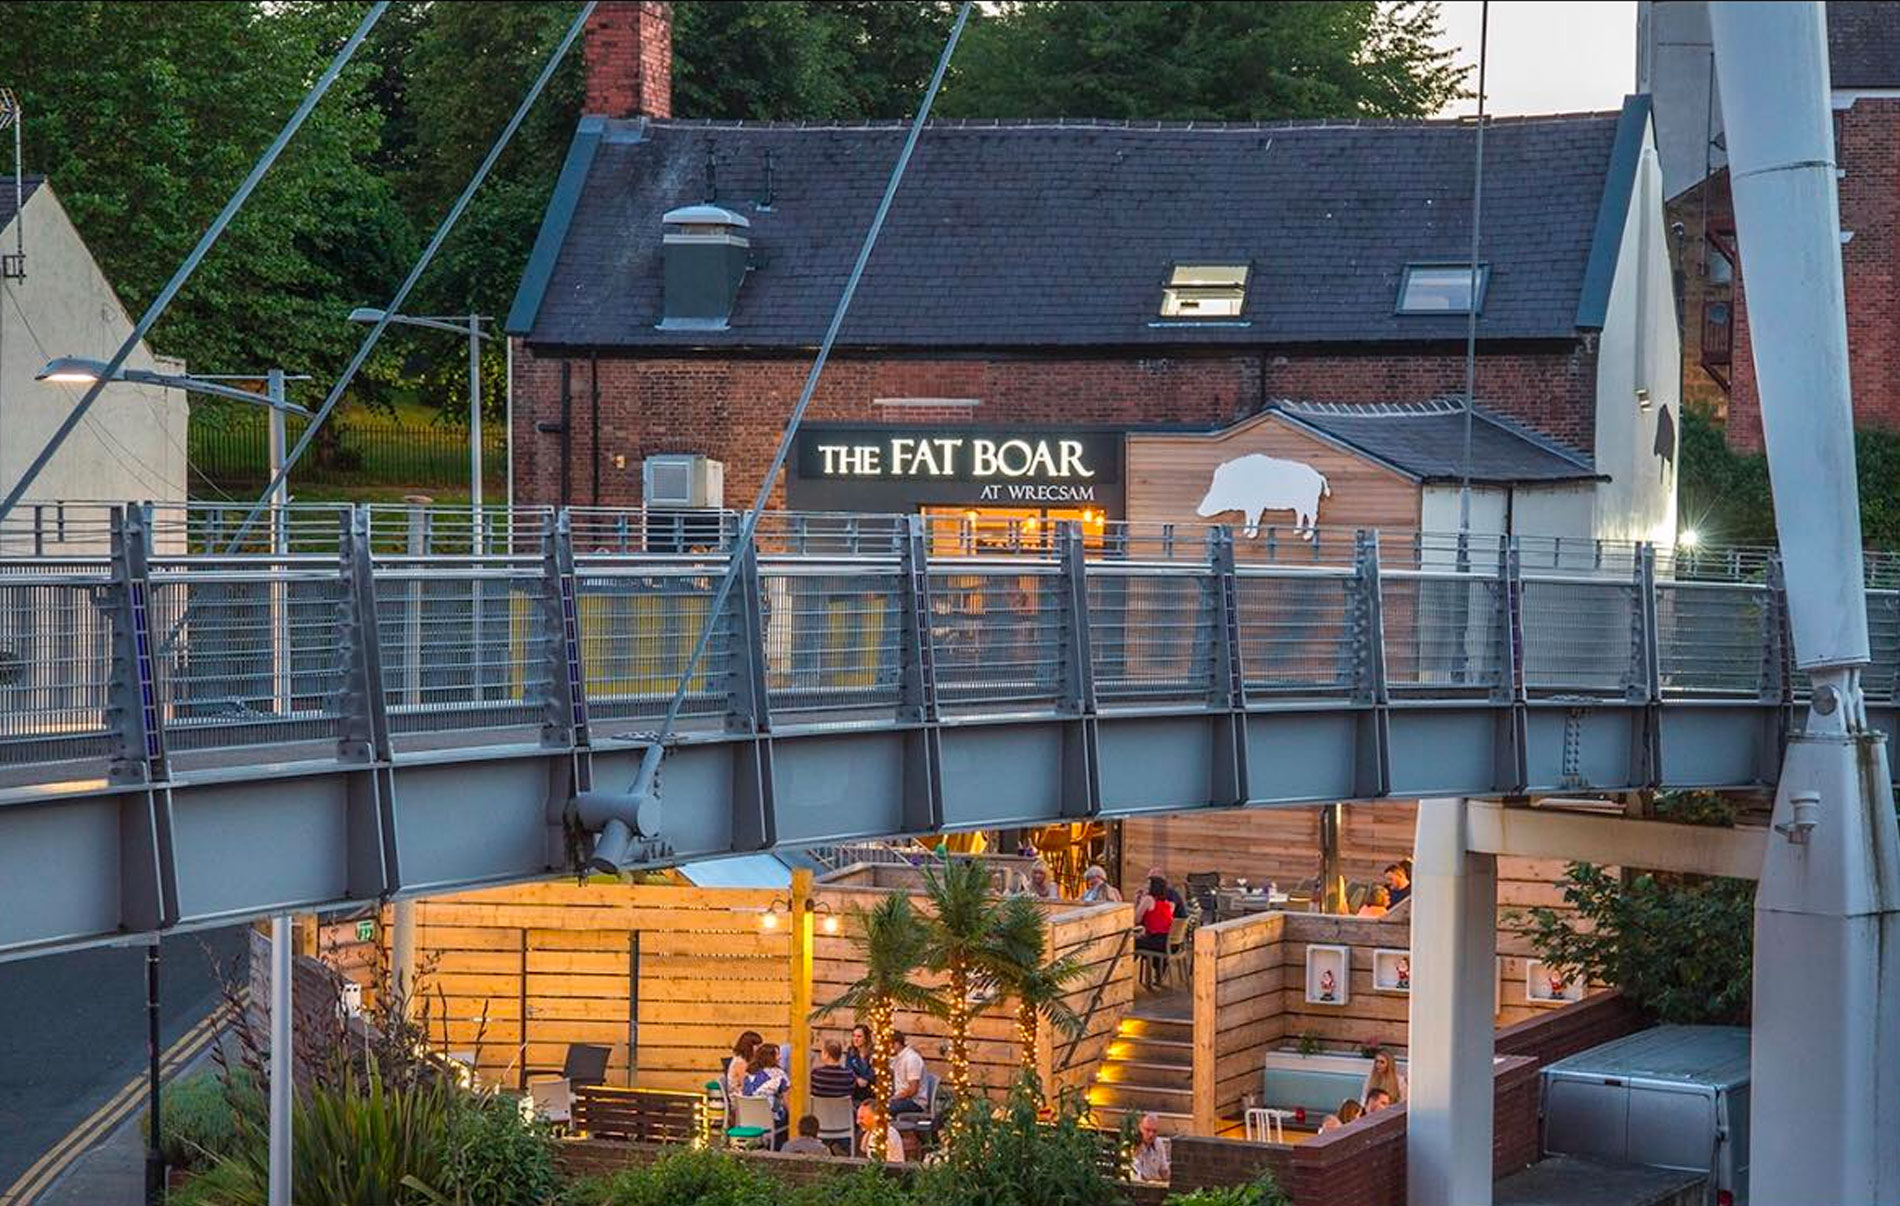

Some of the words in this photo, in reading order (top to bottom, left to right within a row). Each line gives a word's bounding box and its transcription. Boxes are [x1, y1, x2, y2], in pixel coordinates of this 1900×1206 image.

[818, 445, 881, 474] THE
[890, 438, 963, 475] FAT
[972, 438, 1095, 477] BOAR
[980, 485, 1001, 500] AT
[1008, 485, 1094, 501] WRECSAM
